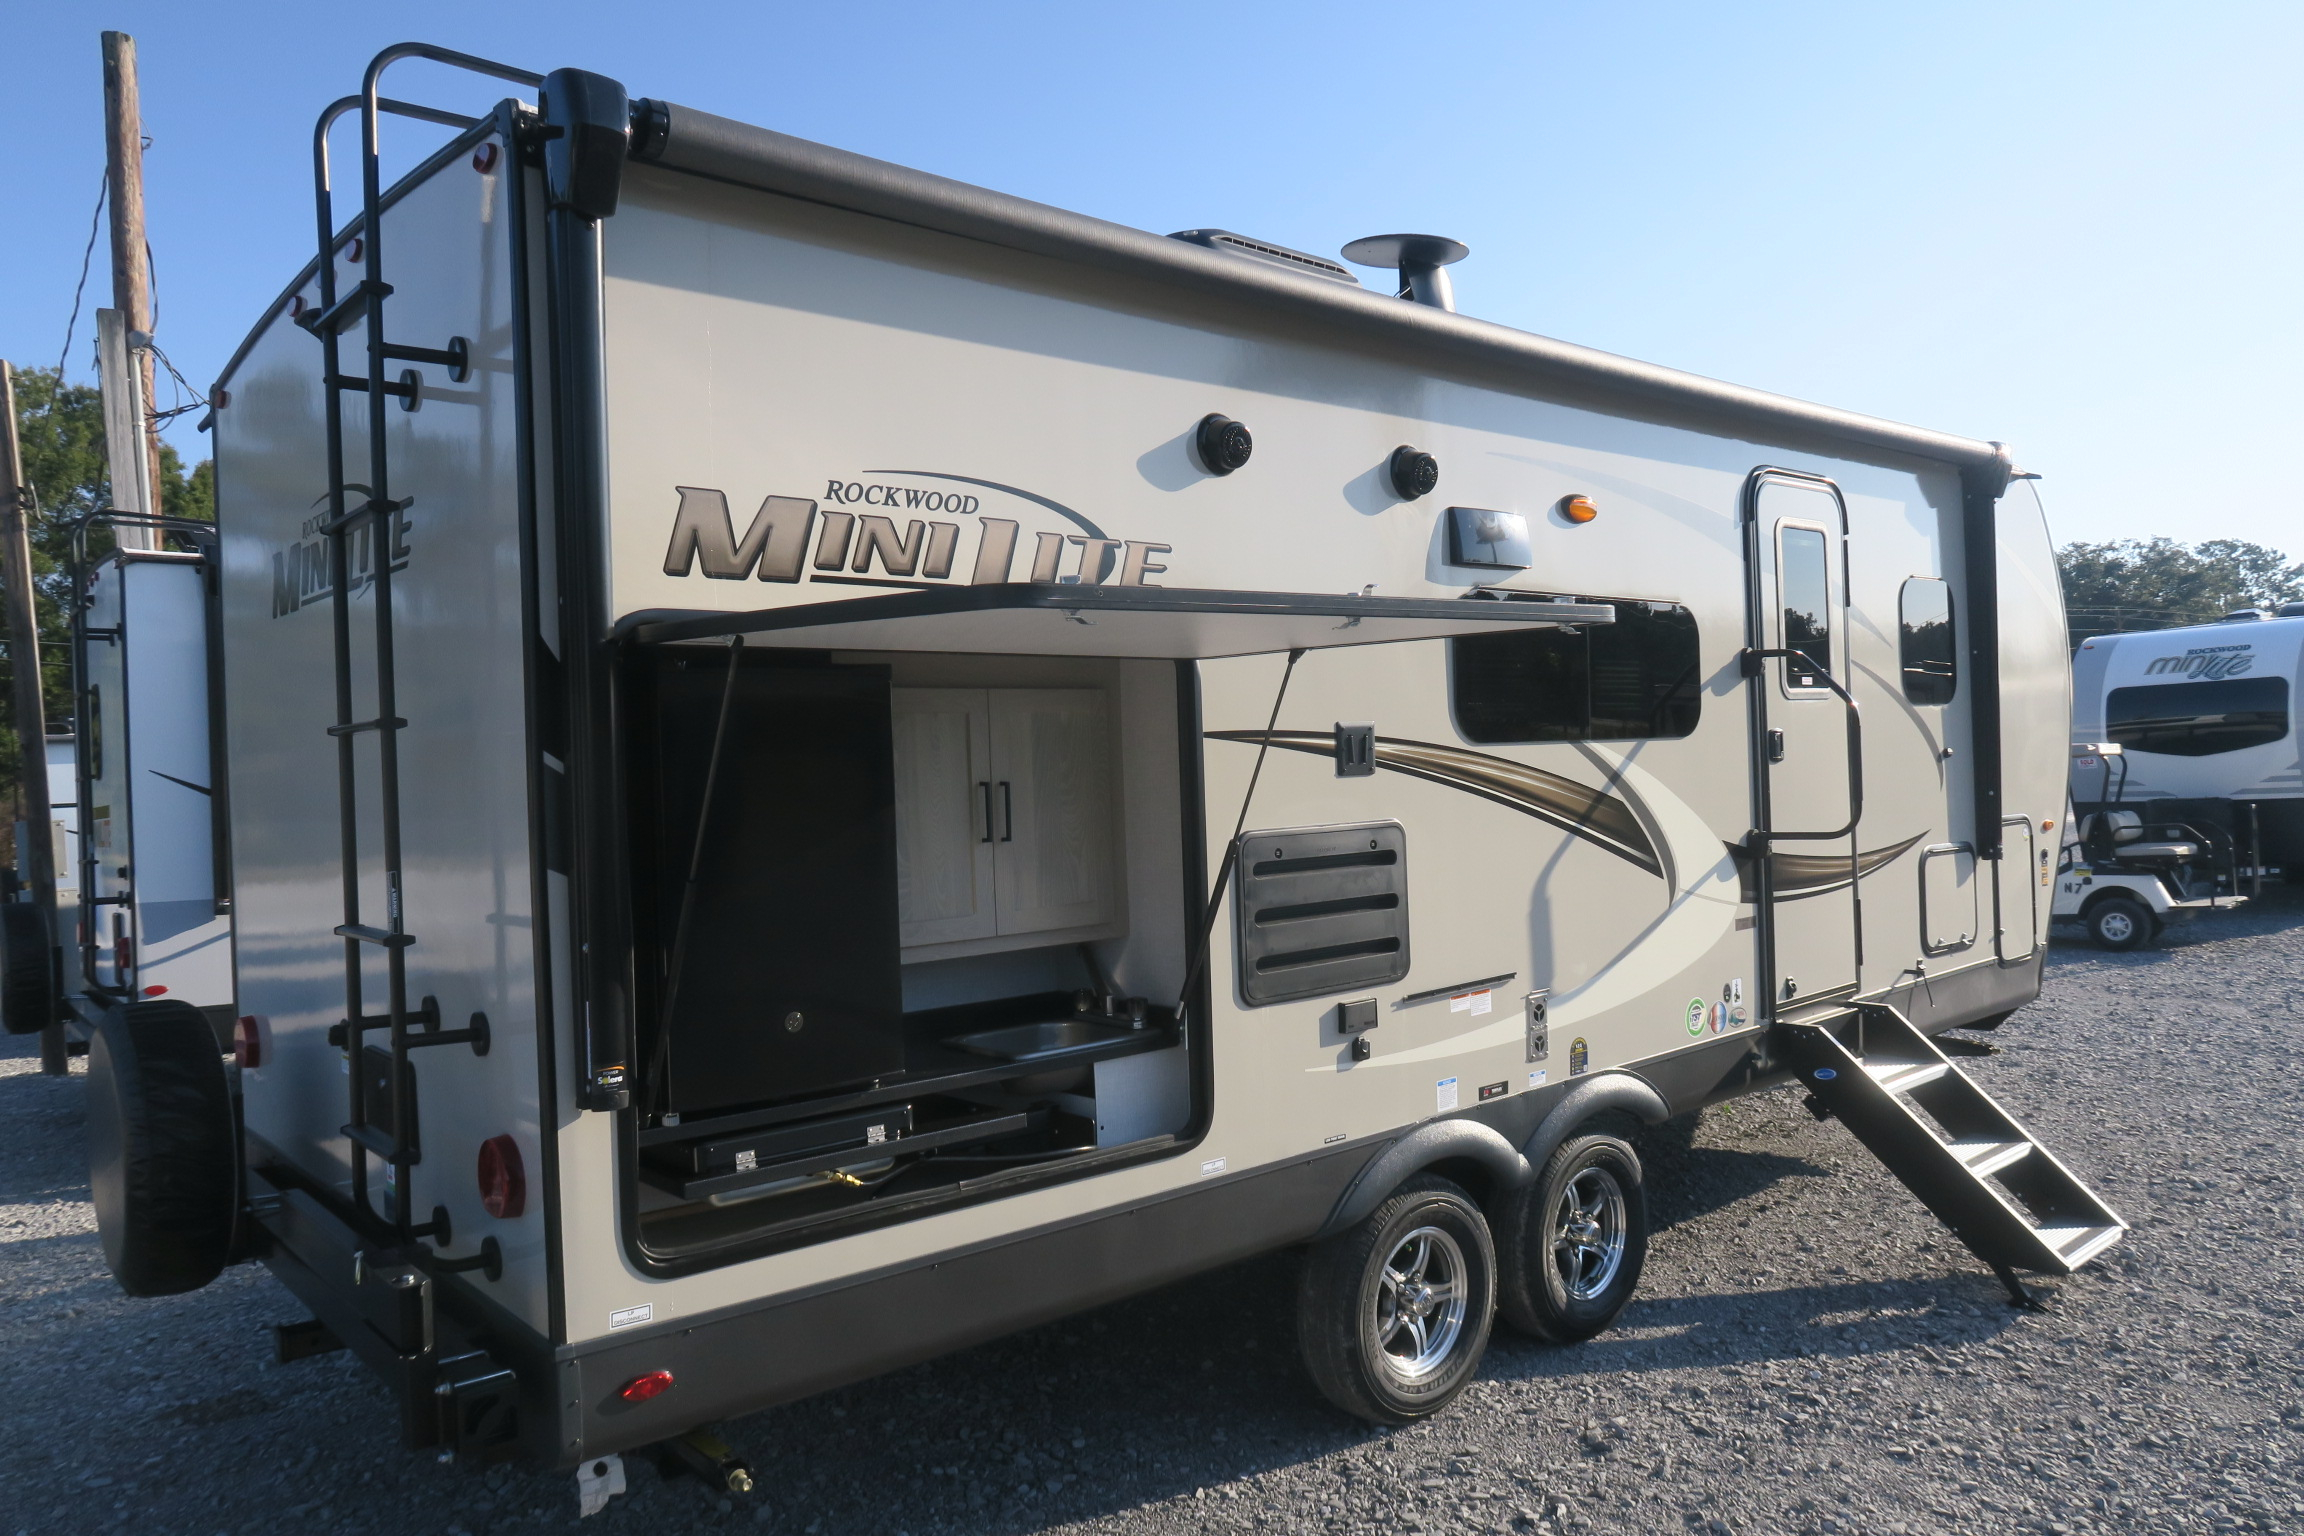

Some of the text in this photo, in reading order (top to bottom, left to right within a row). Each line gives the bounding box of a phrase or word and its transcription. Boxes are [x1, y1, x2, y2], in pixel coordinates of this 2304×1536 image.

[823, 478, 980, 516] ROCKWOOD
[662, 485, 961, 584] MINI
[2186, 644, 2252, 656] ROCKWOOD
[613, 1313, 649, 1326] DISCONNECT
